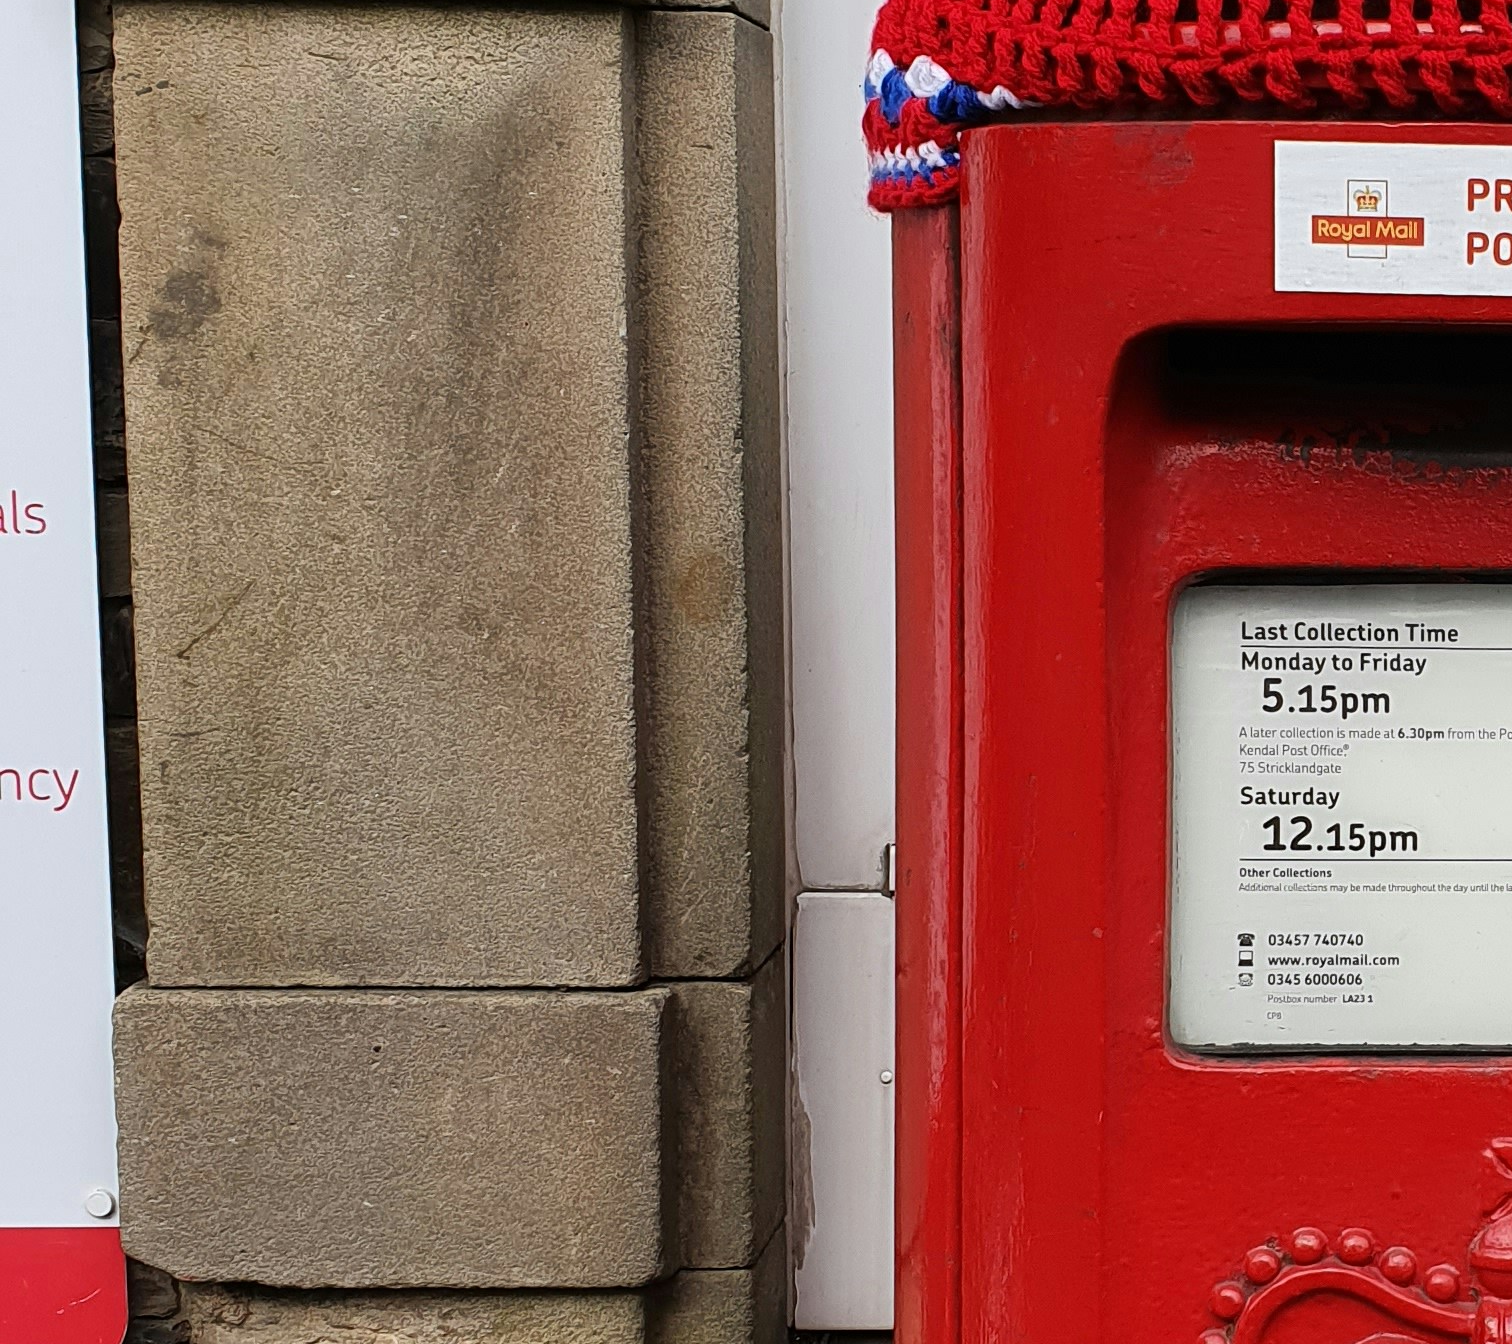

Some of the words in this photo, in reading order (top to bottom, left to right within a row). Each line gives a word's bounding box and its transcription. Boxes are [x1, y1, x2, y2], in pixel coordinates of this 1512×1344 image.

[1317, 219, 1371, 243] Royal
[1375, 221, 1419, 240] Mail
[1241, 621, 1288, 641] Last
[1294, 622, 1399, 643] Collection
[1405, 623, 1459, 643] Time
[1241, 651, 1326, 675] Monday
[1331, 654, 1352, 671] to
[1360, 653, 1427, 676] Friday
[1261, 677, 1390, 719] 5.15pm
[1239, 727, 1248, 739] A
[1250, 727, 1277, 739] later
[1279, 727, 1334, 739] collection
[1336, 728, 1346, 739] is
[1349, 728, 1381, 739] made
[1384, 728, 1395, 739] at
[1397, 728, 1445, 742] 6.30pm
[1447, 728, 1475, 740] from
[1478, 728, 1496, 740] the
[1239, 744, 1278, 756] Kendal
[1282, 744, 1308, 756] Post
[1239, 762, 1255, 774] 75
[1257, 762, 1342, 776] Stricklandgate
[1240, 786, 1340, 809] Saturday
[1262, 815, 1418, 857] 12.15pm
[1239, 867, 1270, 878] Other
[1273, 867, 1332, 878] Collections
[1238, 882, 1282, 892] Additional
[1283, 883, 1328, 892] collections
[1330, 883, 1348, 894] may
[1350, 883, 1360, 892] be
[1362, 883, 1387, 892] made
[1388, 883, 1436, 894] throughout
[1437, 883, 1452, 892] the
[1453, 883, 1468, 894] day
[1470, 883, 1489, 892] until
[1490, 883, 1504, 892] the
[1268, 934, 1310, 946] 03457
[1313, 934, 1364, 947] 740740
[1268, 954, 1400, 967] www.royalmail.com
[1267, 973, 1301, 986] 0345
[1305, 973, 1363, 986] 6000606
[1267, 994, 1301, 1004] Postbox
[1304, 995, 1337, 1004] number
[1342, 994, 1365, 1004] LA23
[1367, 994, 1374, 1003] 1
